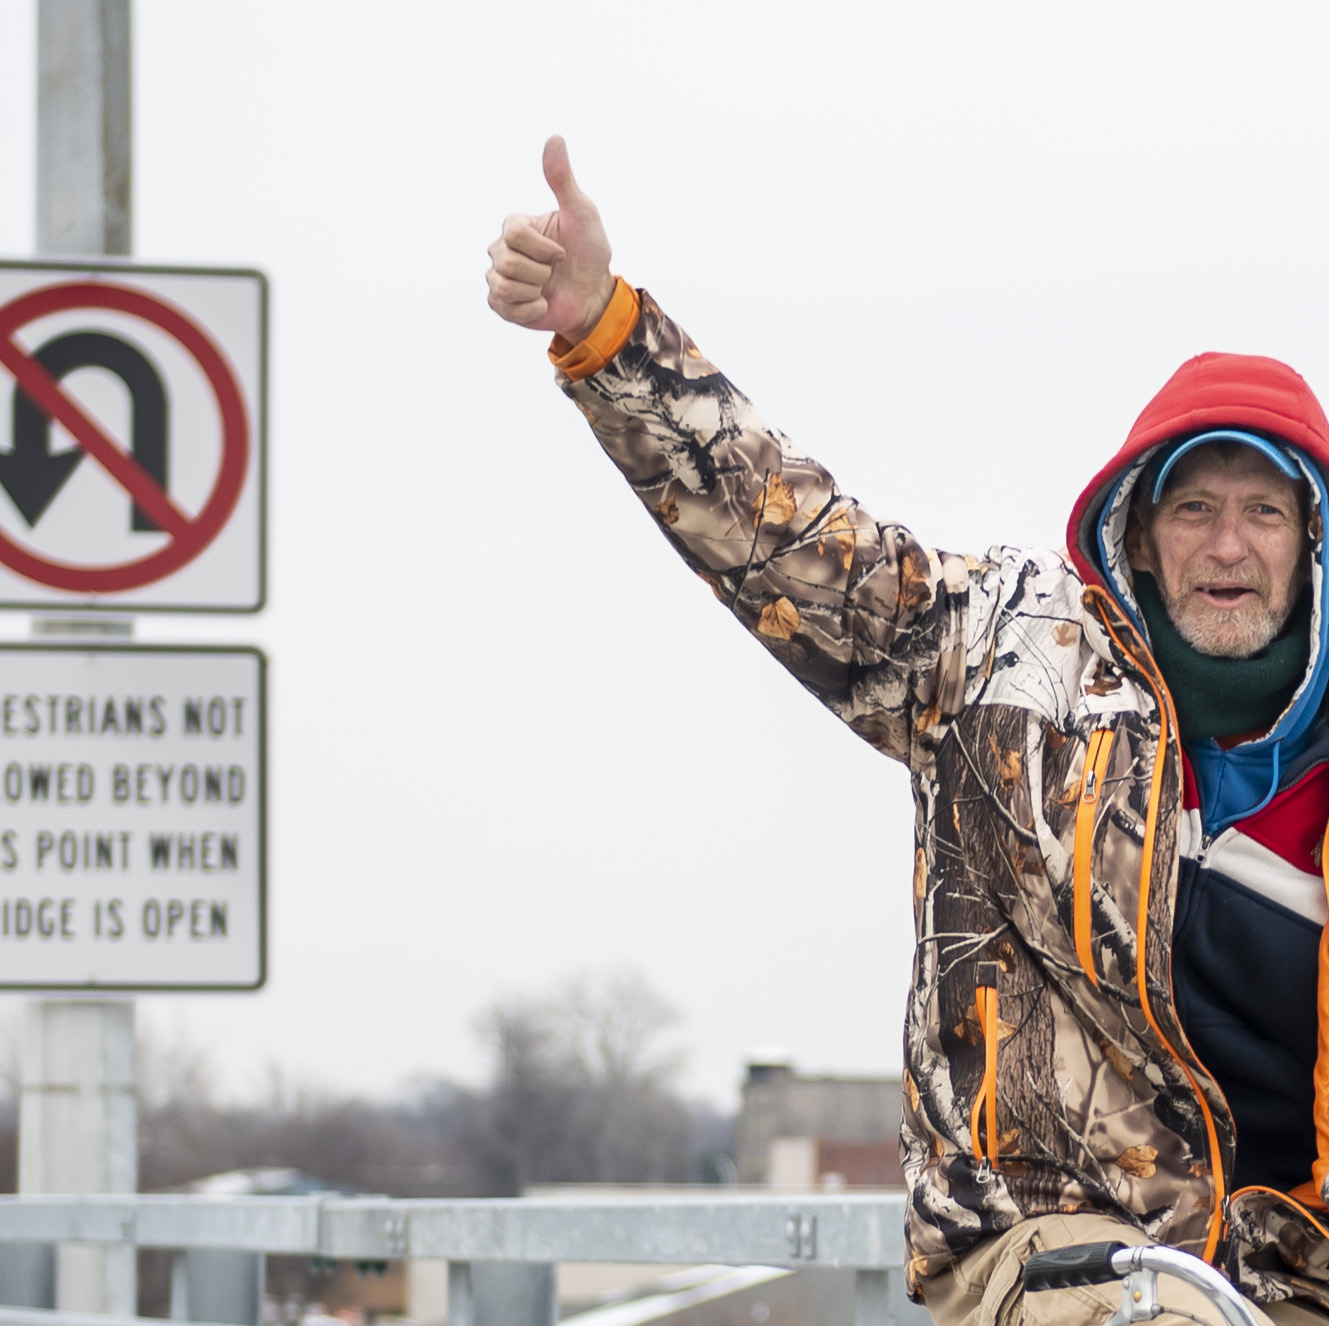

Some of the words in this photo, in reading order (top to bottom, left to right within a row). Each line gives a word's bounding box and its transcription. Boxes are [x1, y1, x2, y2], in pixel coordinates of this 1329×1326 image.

[183, 696, 245, 739] NOT
[112, 764, 245, 806] BEYOND
[37, 831, 129, 870] POINT
[149, 832, 238, 872] WHEN
[95, 900, 123, 938] IS
[143, 899, 227, 939] OPEN
